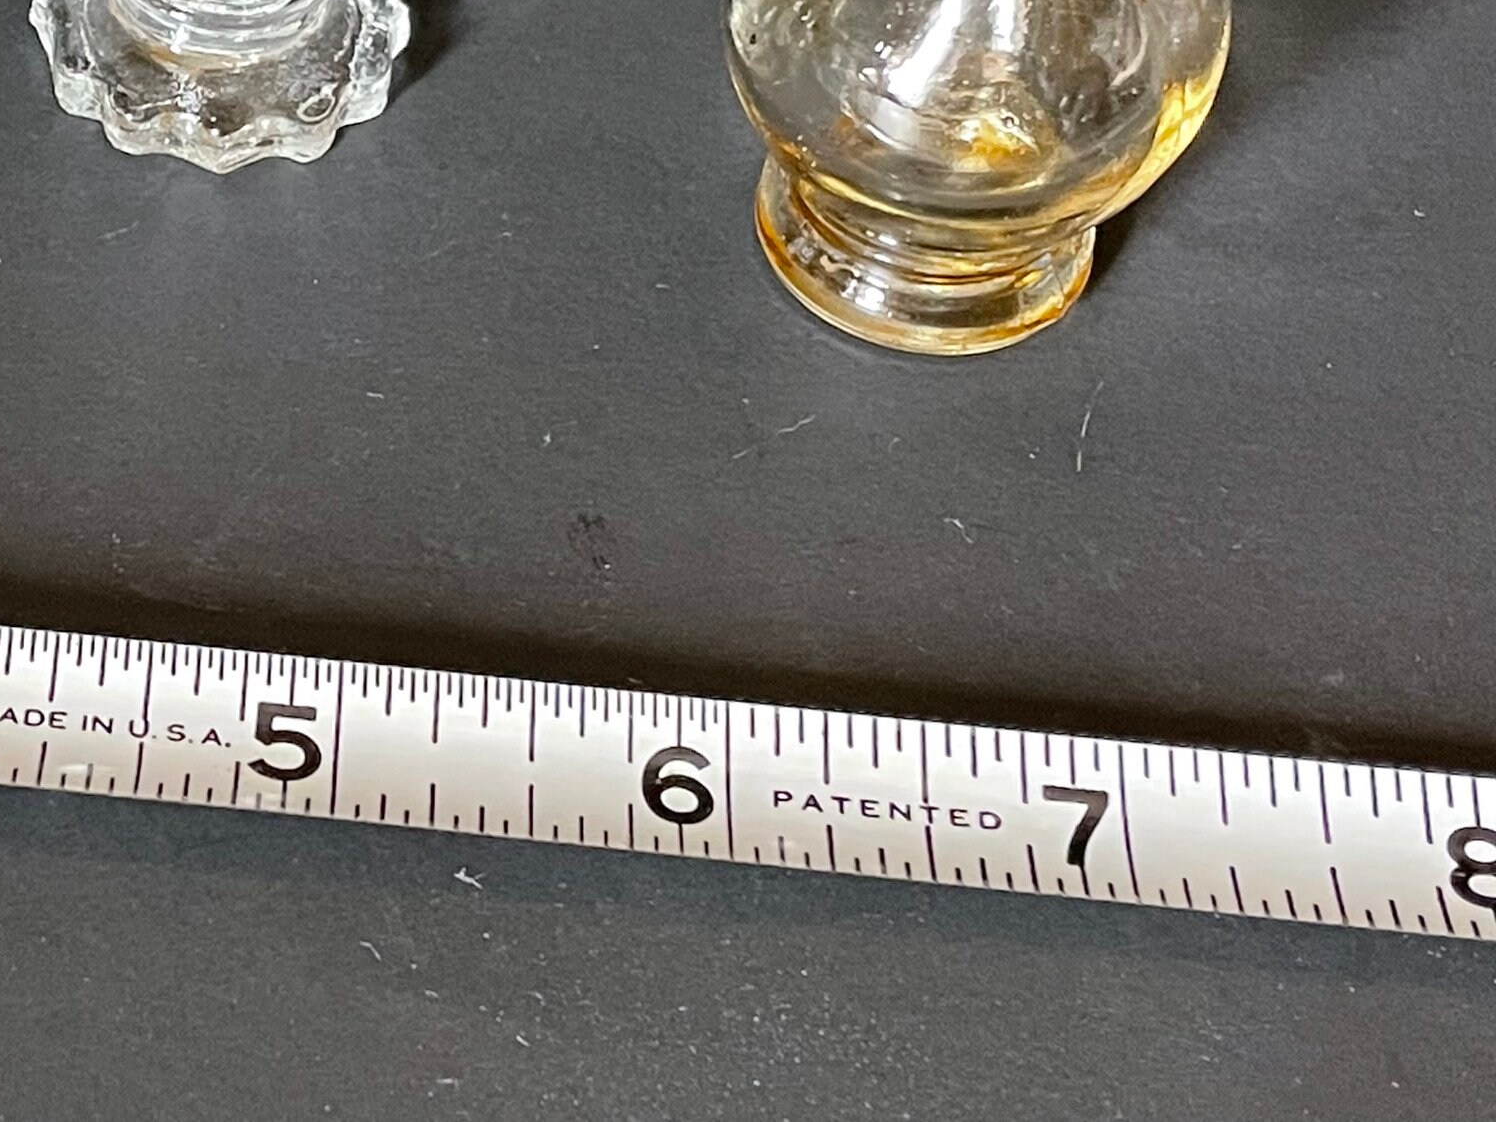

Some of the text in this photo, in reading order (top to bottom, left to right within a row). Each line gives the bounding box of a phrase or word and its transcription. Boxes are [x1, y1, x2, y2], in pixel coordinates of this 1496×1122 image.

[82, 714, 114, 734] IN
[248, 702, 322, 782] 5
[642, 746, 714, 825] 6
[772, 789, 1004, 831] PATENTED
[1043, 785, 1109, 866] 7
